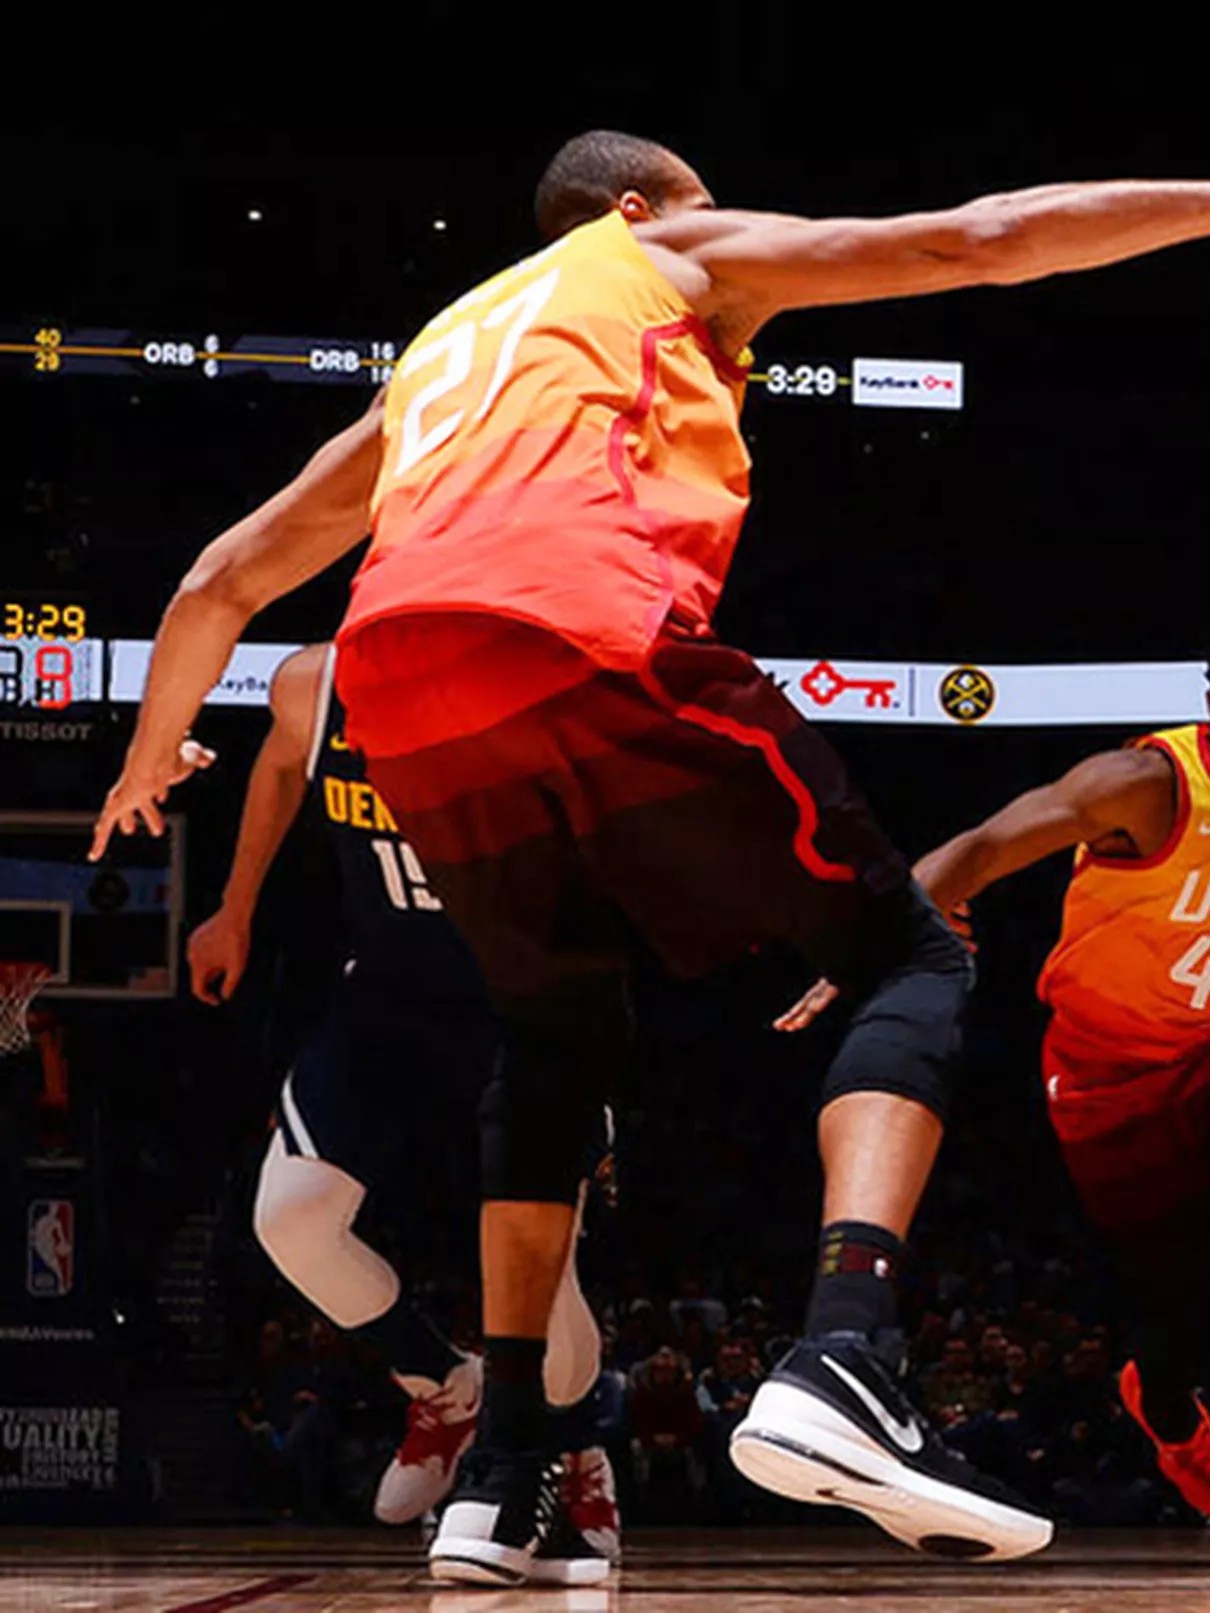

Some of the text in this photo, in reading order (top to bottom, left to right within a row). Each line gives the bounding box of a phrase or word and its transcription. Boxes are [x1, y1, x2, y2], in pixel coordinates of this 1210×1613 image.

[143, 342, 196, 365] ORB
[309, 350, 360, 372] DRB
[394, 267, 561, 478] 27
[766, 364, 837, 396] 3:29
[4, 603, 86, 643] 3:29
[0, 721, 93, 742] TISSOT
[323, 774, 400, 833] DEN
[3, 1424, 100, 1450] UALITY
